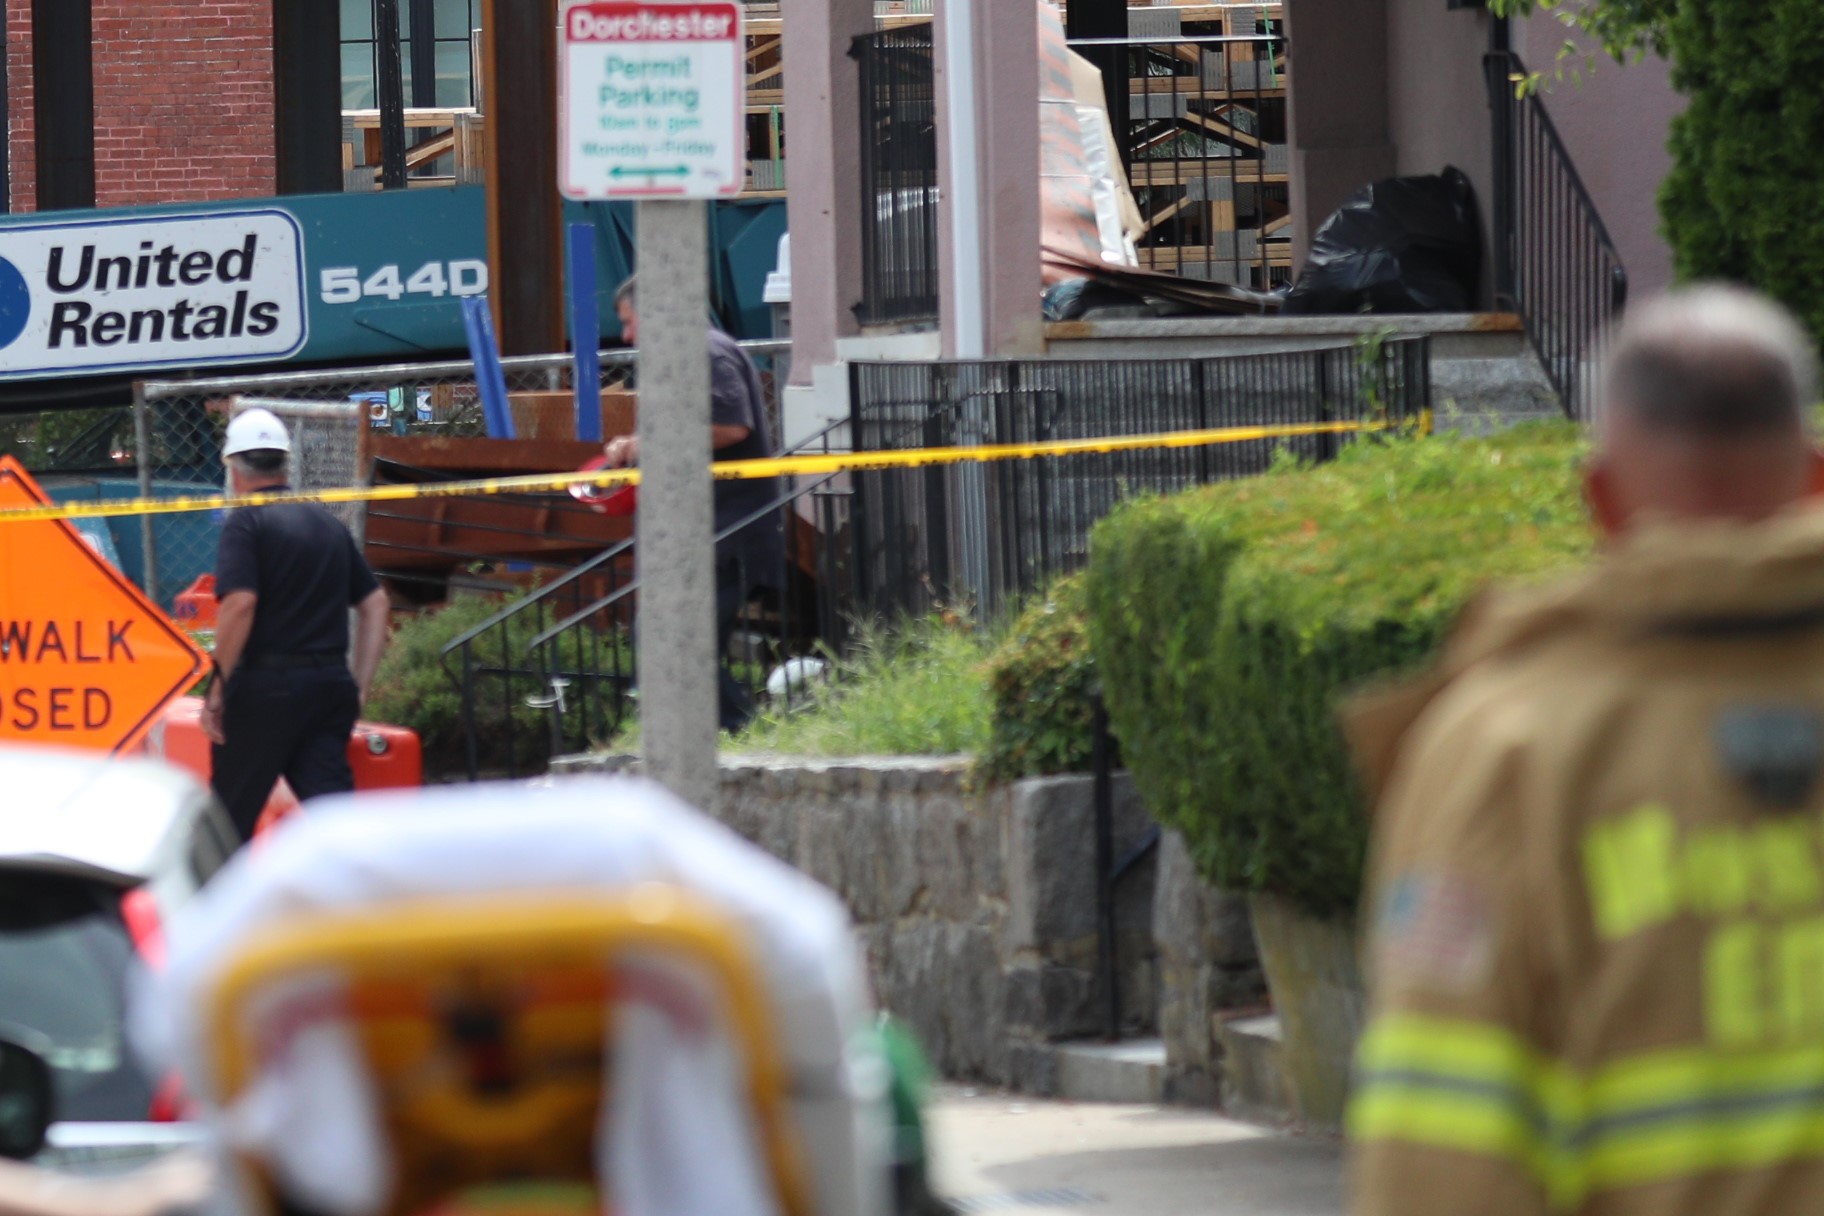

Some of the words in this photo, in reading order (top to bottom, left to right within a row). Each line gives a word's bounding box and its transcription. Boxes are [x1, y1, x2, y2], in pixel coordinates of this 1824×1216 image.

[571, 9, 733, 41] Dorchester
[604, 55, 692, 81] Permit
[599, 83, 700, 113] Parking
[581, 140, 647, 160] Monday
[45, 234, 259, 294] United
[320, 258, 488, 304] 544D
[46, 290, 280, 350] Rentals
